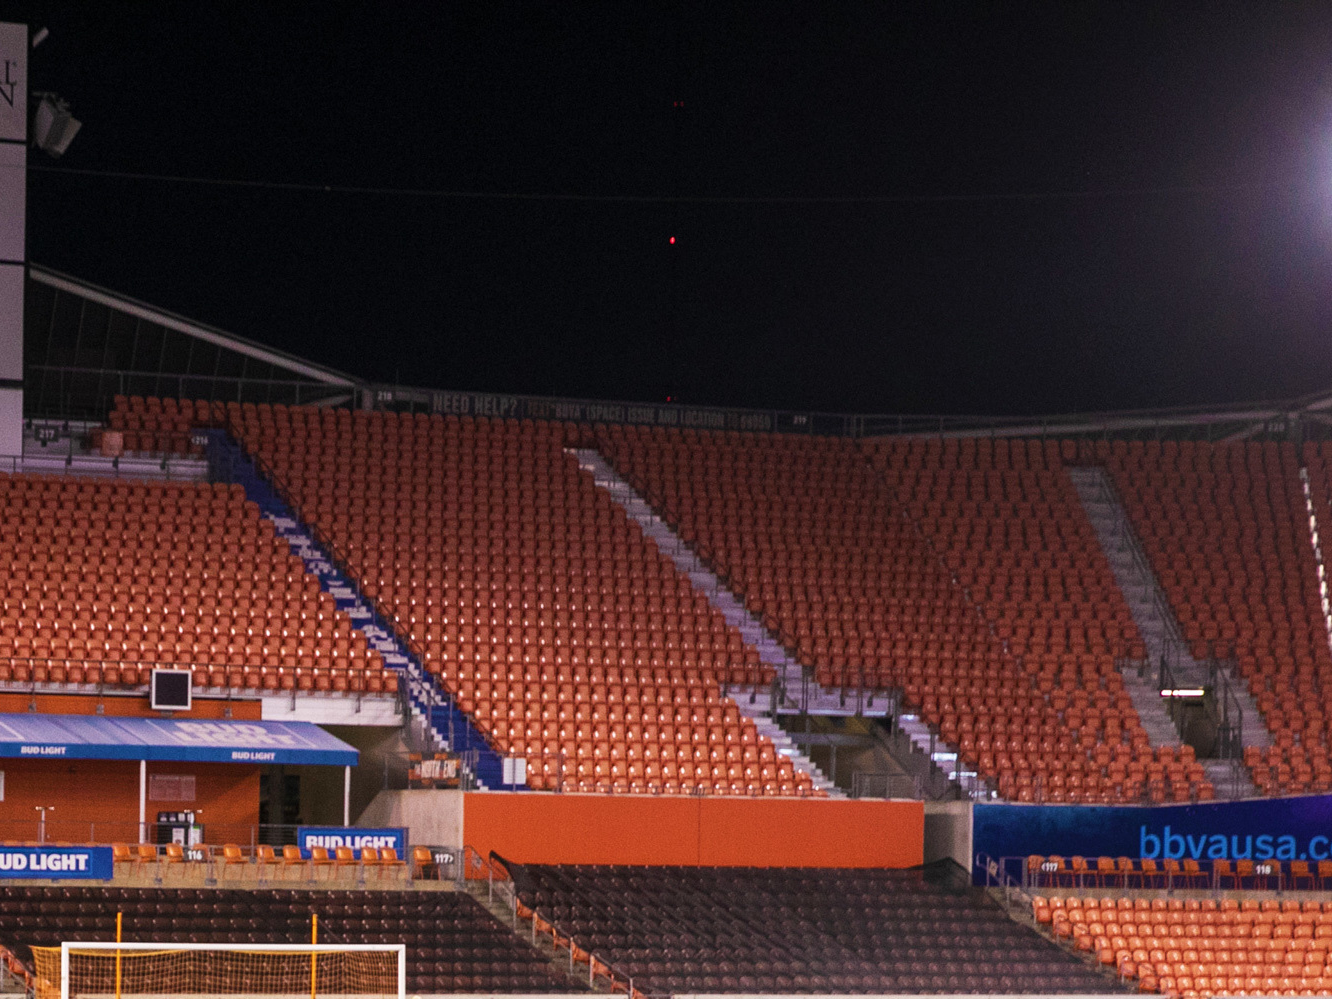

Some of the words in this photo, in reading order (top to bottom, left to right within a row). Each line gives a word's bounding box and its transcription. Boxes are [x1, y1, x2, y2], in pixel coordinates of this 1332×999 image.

[432, 392, 469, 414] NEED
[474, 395, 518, 416] HELP?
[21, 745, 39, 755] BUD
[40, 745, 66, 755] LIGHT
[231, 751, 250, 760] BUD
[251, 752, 276, 761] LIGHT
[306, 835, 344, 849] BUD
[345, 836, 397, 849] LIGHT
[1140, 825, 1332, 861] bbvausa.c
[186, 849, 202, 860] 116
[434, 853, 449, 864] 117
[29, 853, 88, 871] LIGHT
